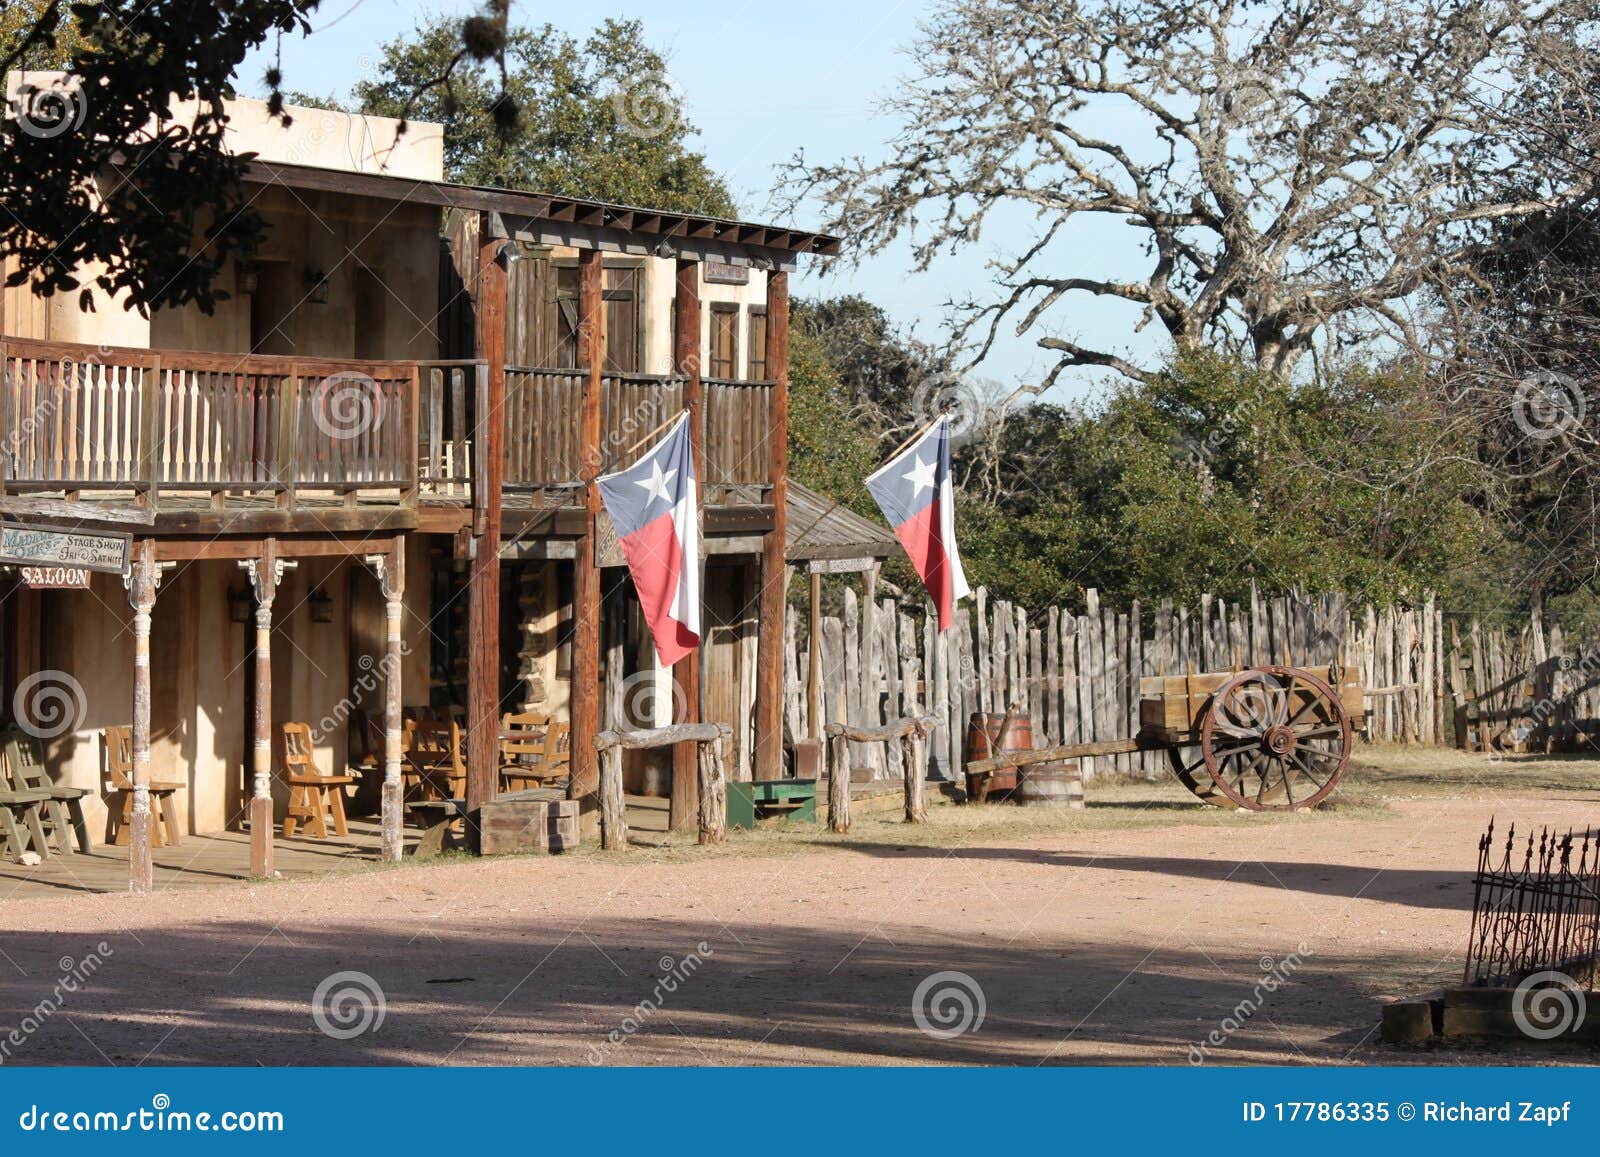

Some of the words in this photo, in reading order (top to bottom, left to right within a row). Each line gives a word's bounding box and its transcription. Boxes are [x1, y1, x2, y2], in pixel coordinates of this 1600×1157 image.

[67, 535, 95, 548] STAGE
[96, 538, 124, 551] SHOW
[21, 567, 88, 585] SALOON
